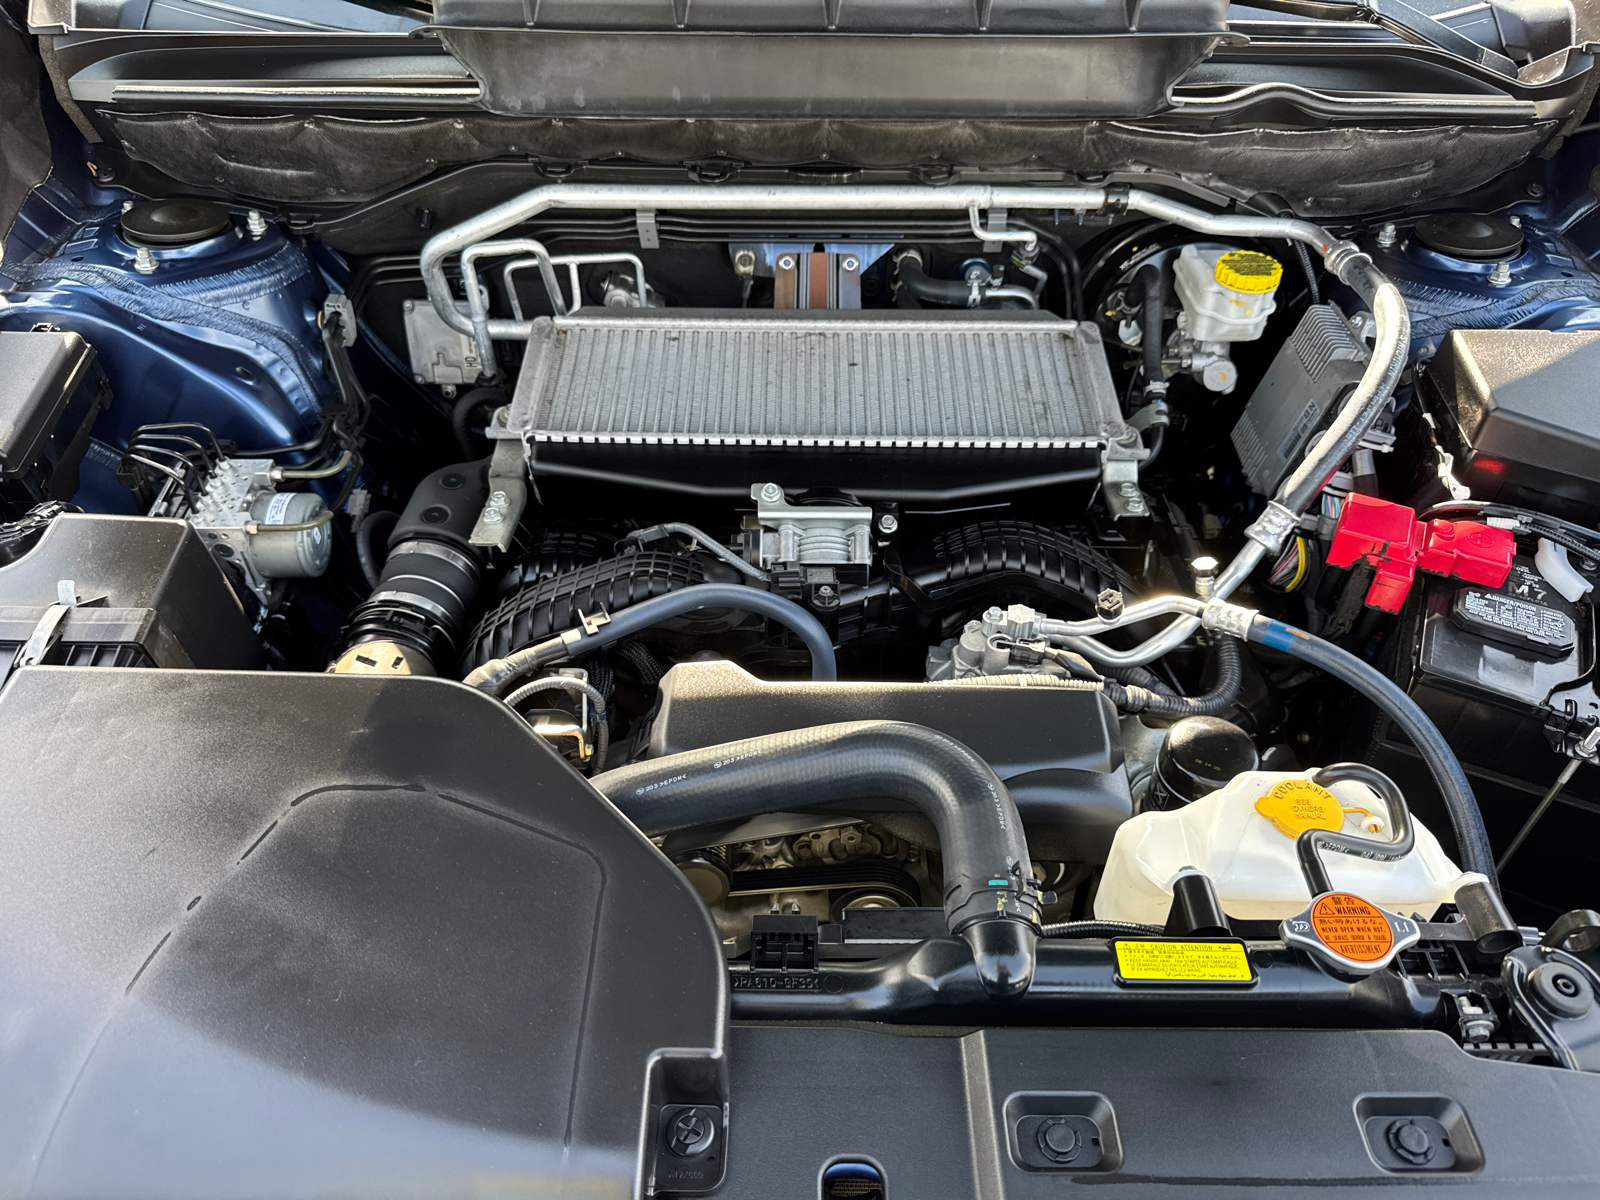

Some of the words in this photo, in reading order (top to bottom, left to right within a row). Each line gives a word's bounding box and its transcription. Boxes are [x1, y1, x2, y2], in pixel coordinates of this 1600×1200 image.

[464, 356, 478, 368] HD
[1491, 595, 1537, 612] DANGER/POISON
[645, 783, 659, 792] 203
[1273, 781, 1333, 800] COOLANT
[1294, 812, 1327, 821] MANUAL
[1334, 906, 1371, 915] WARNING
